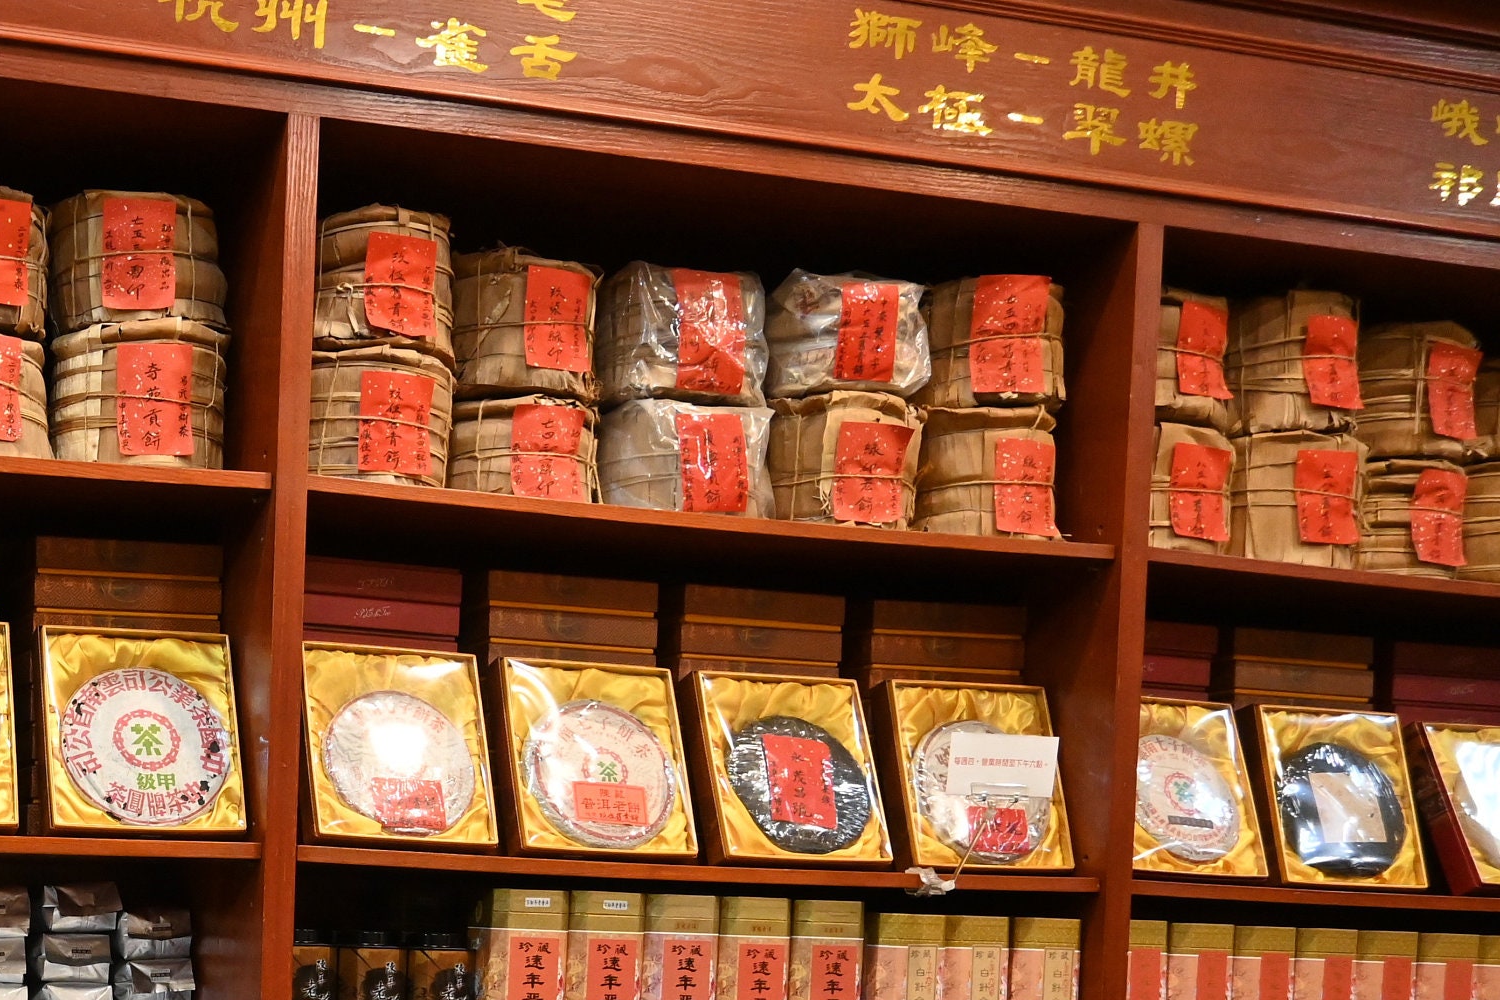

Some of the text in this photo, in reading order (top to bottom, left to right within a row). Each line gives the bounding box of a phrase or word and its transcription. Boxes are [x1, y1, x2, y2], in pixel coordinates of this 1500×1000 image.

[1431, 99, 1500, 147] 峨
[131, 723, 165, 756] 茶
[597, 761, 618, 783] 茶
